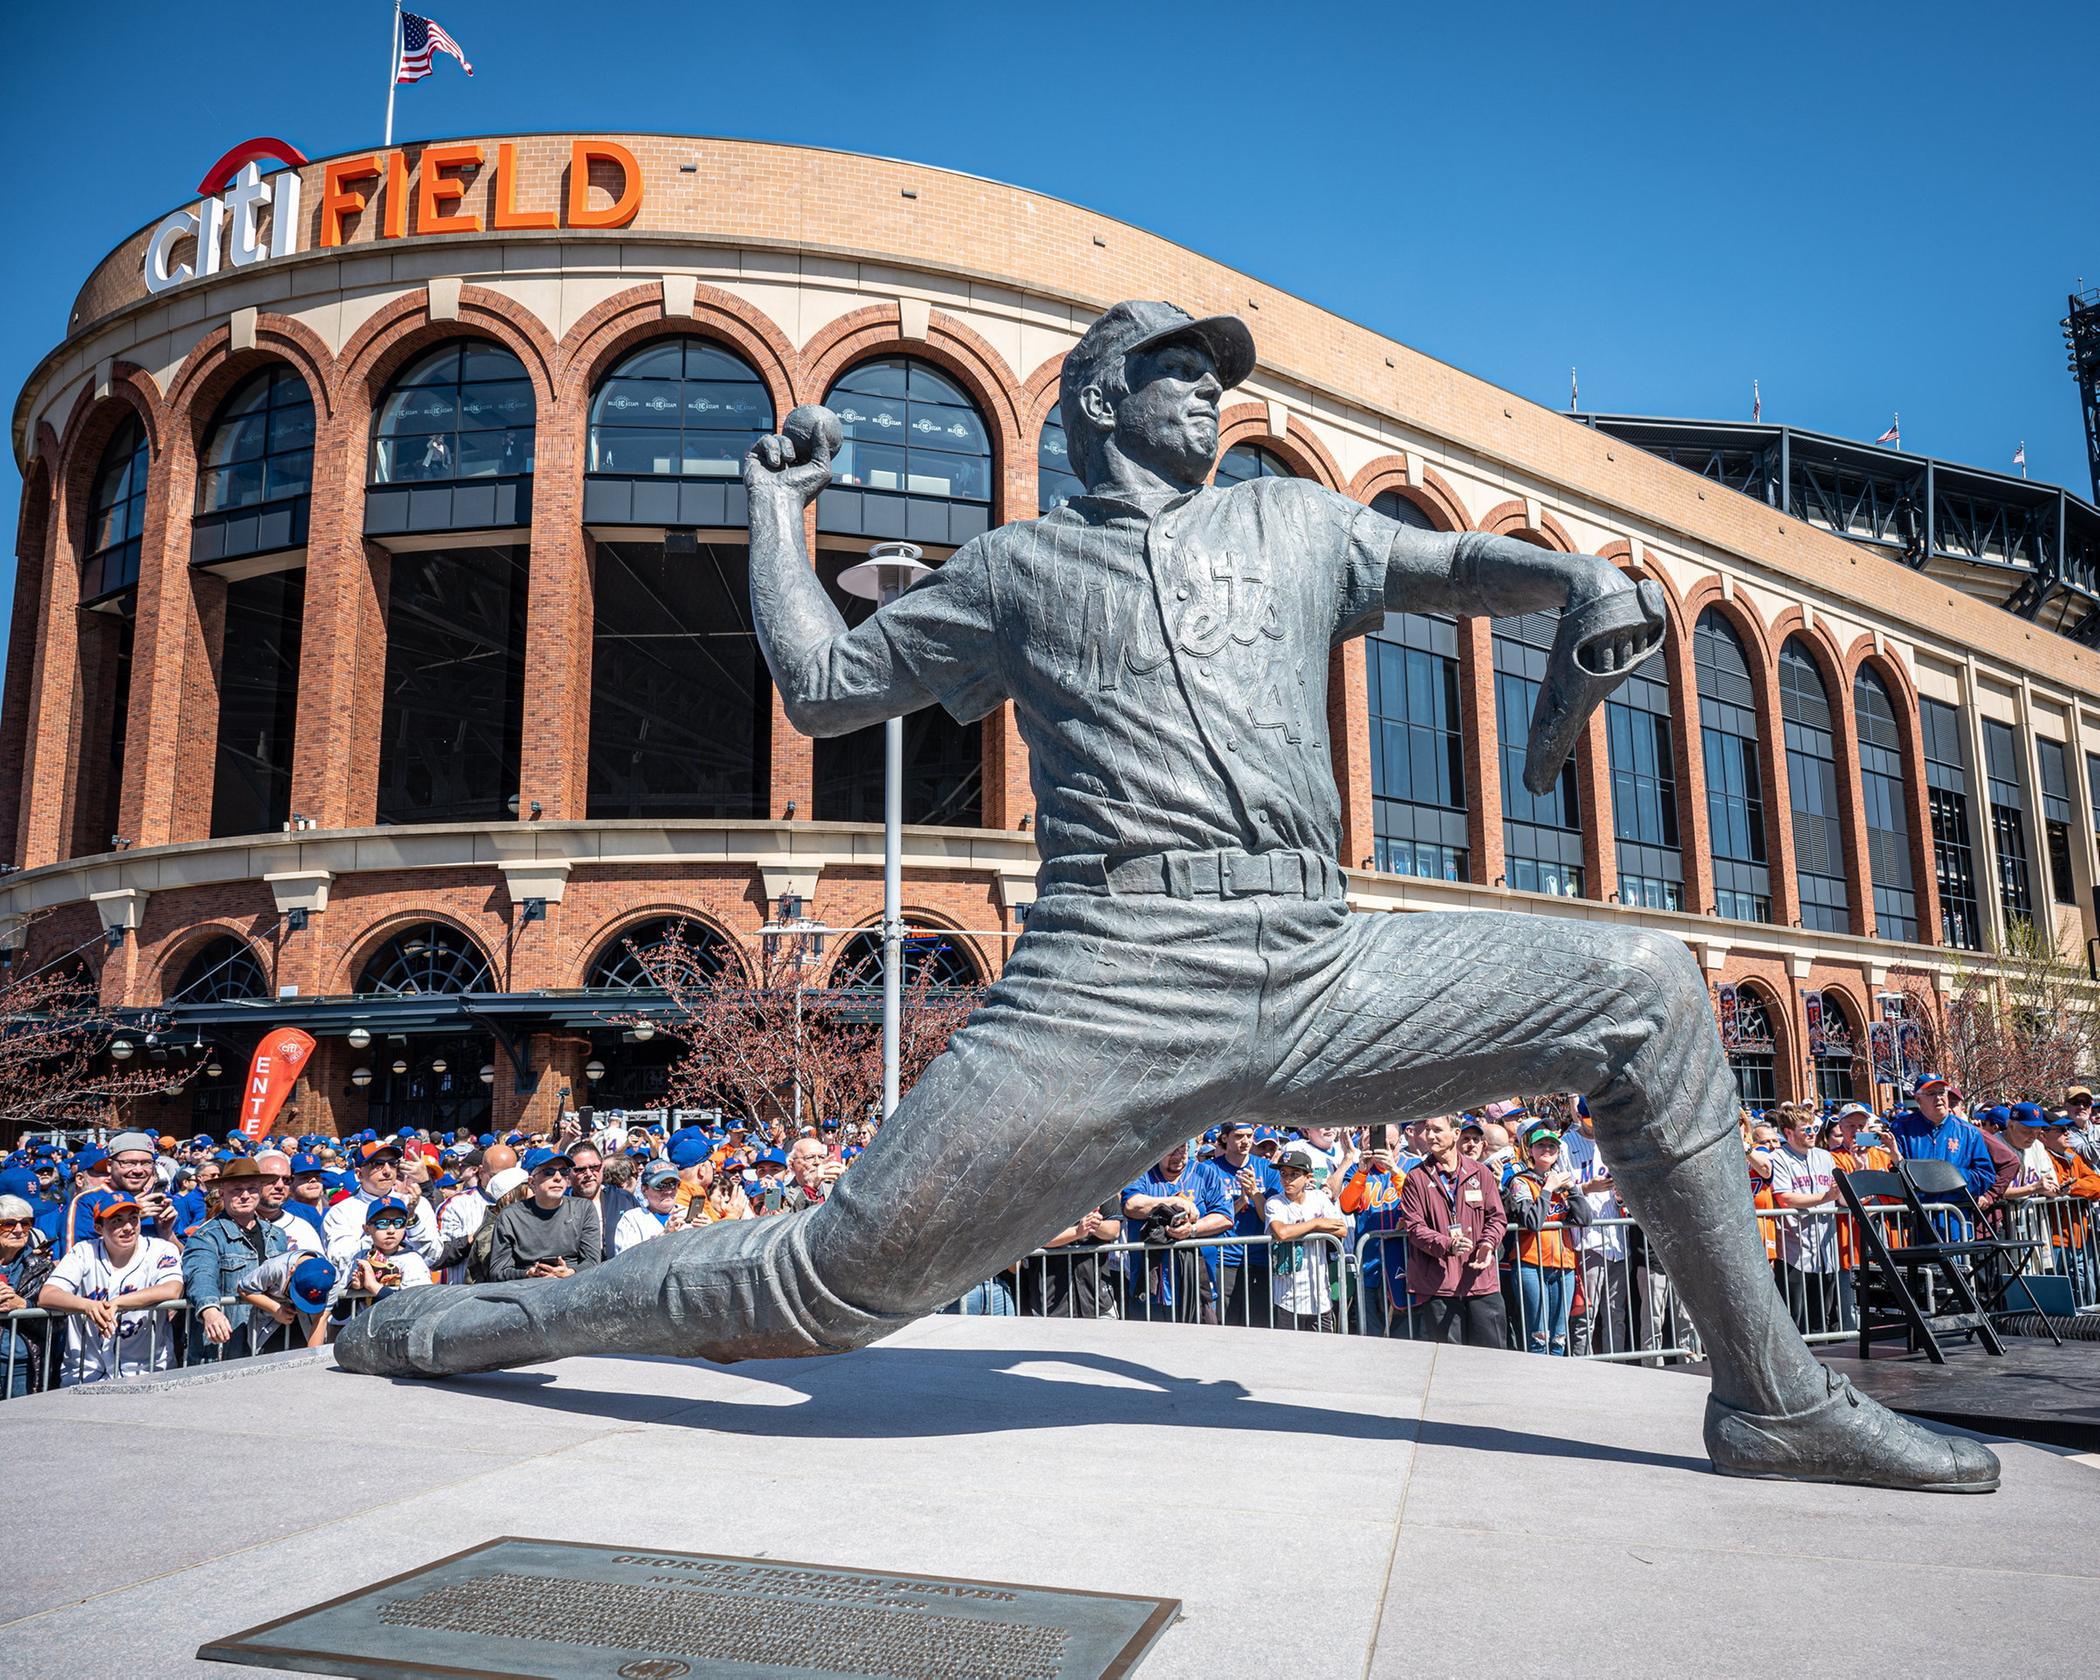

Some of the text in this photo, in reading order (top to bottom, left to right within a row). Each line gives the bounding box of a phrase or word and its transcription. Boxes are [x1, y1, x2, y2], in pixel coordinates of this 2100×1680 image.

[144, 140, 643, 293] citi FIELD
[1080, 551, 1287, 691] Mets
[281, 1043, 297, 1053] citi
[246, 1056, 271, 1134] ENTE
[601, 1137, 617, 1154] 14
[1363, 1180, 1400, 1212] Me
[2012, 1167, 2040, 1188] Mts
[609, 1555, 1019, 1600] GEORGE THOMAS SEAVER
